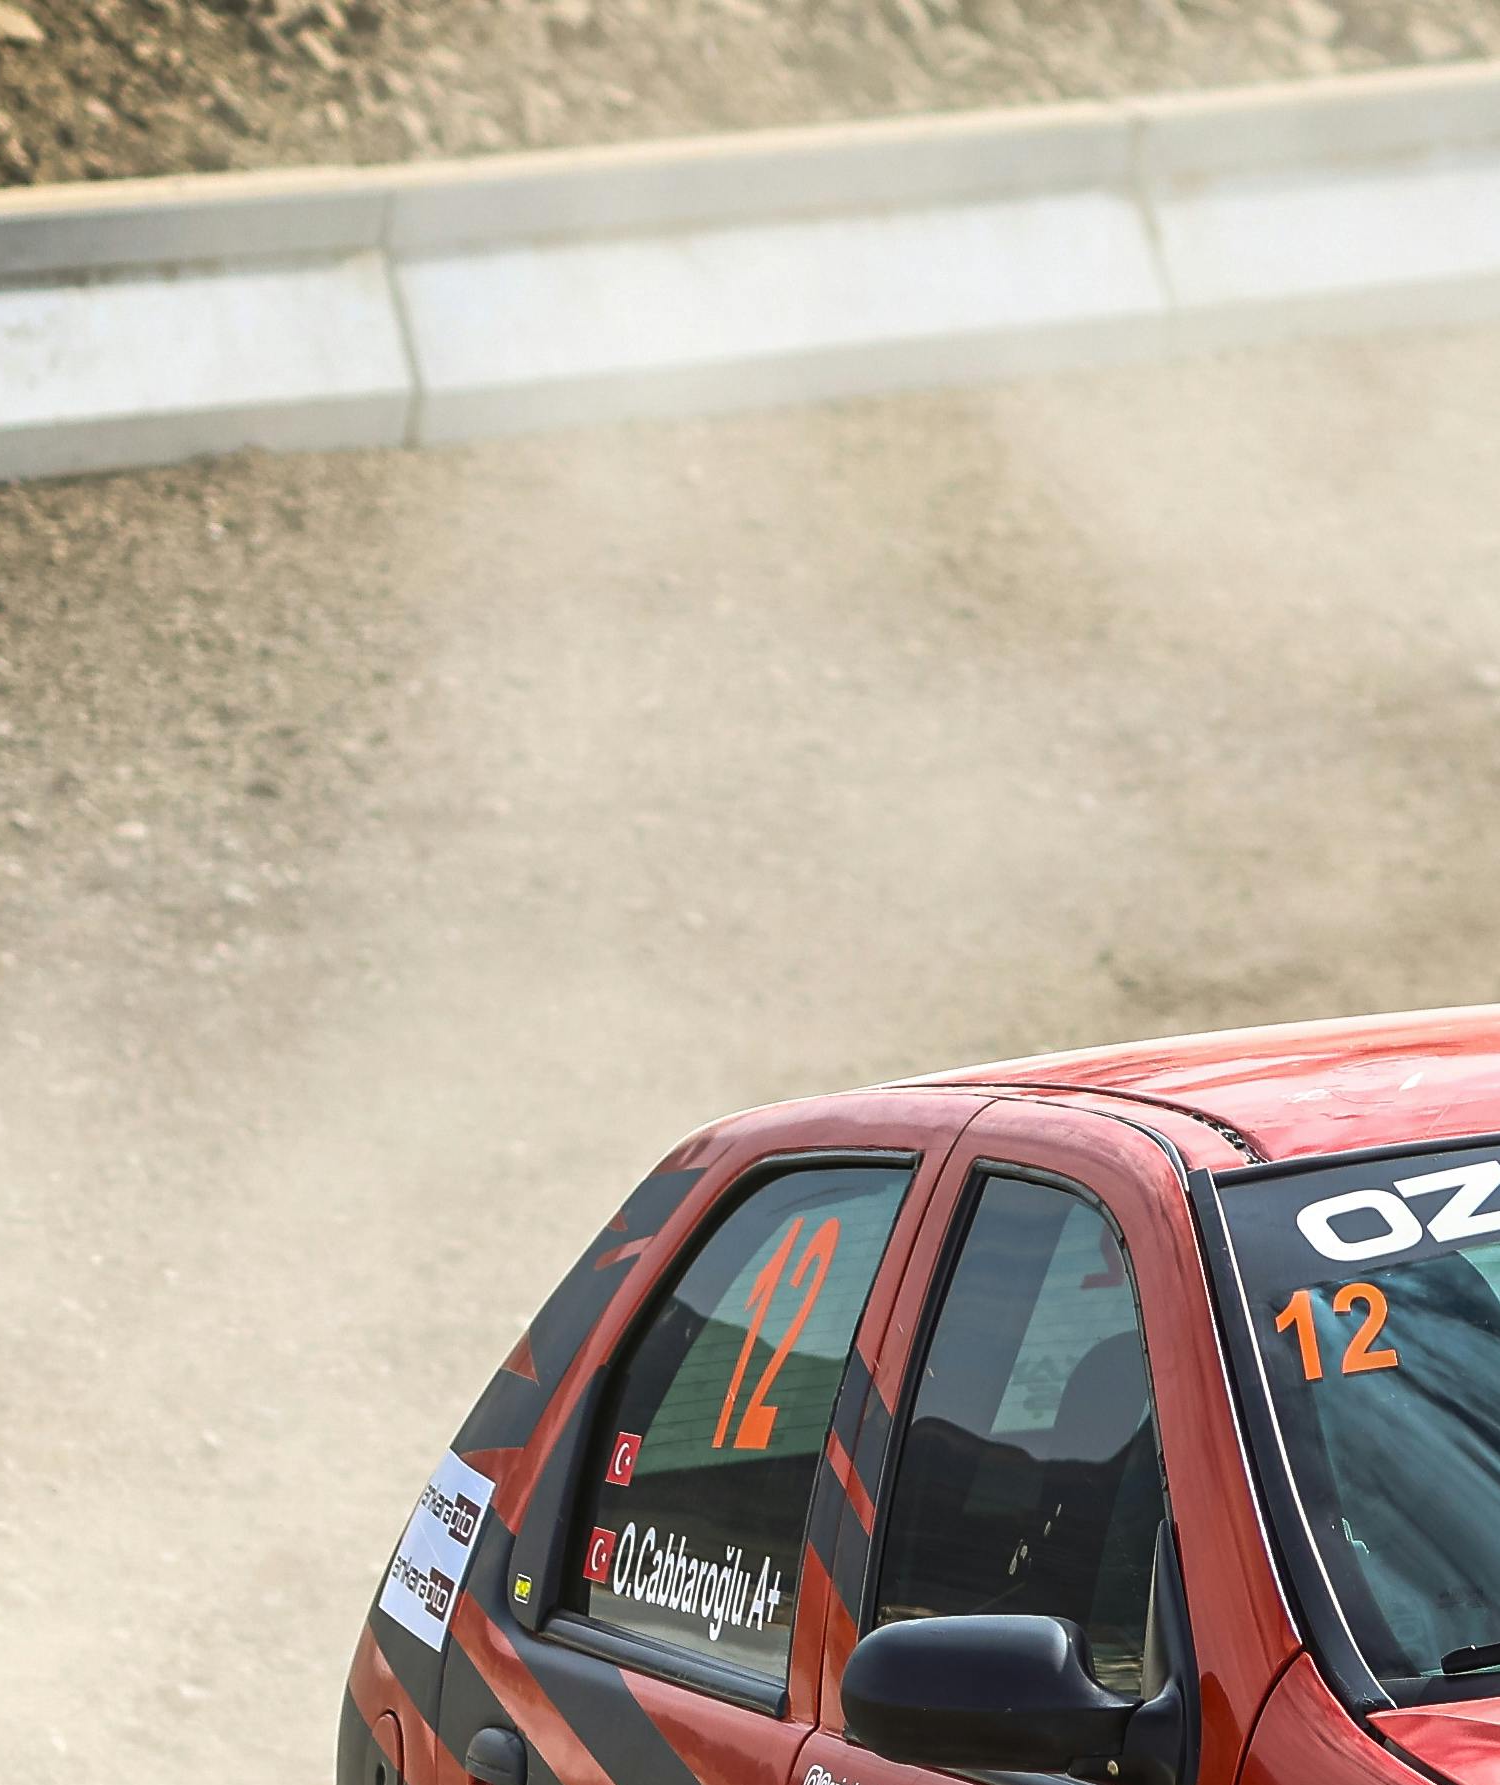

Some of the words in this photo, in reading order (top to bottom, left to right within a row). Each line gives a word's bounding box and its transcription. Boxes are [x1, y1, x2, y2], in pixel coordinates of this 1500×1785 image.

[711, 1216, 841, 1449] 12
[1275, 1283, 1398, 1381] 12
[613, 1522, 750, 1641] O.Cabbaroğlu
[746, 1556, 781, 1631] A+
